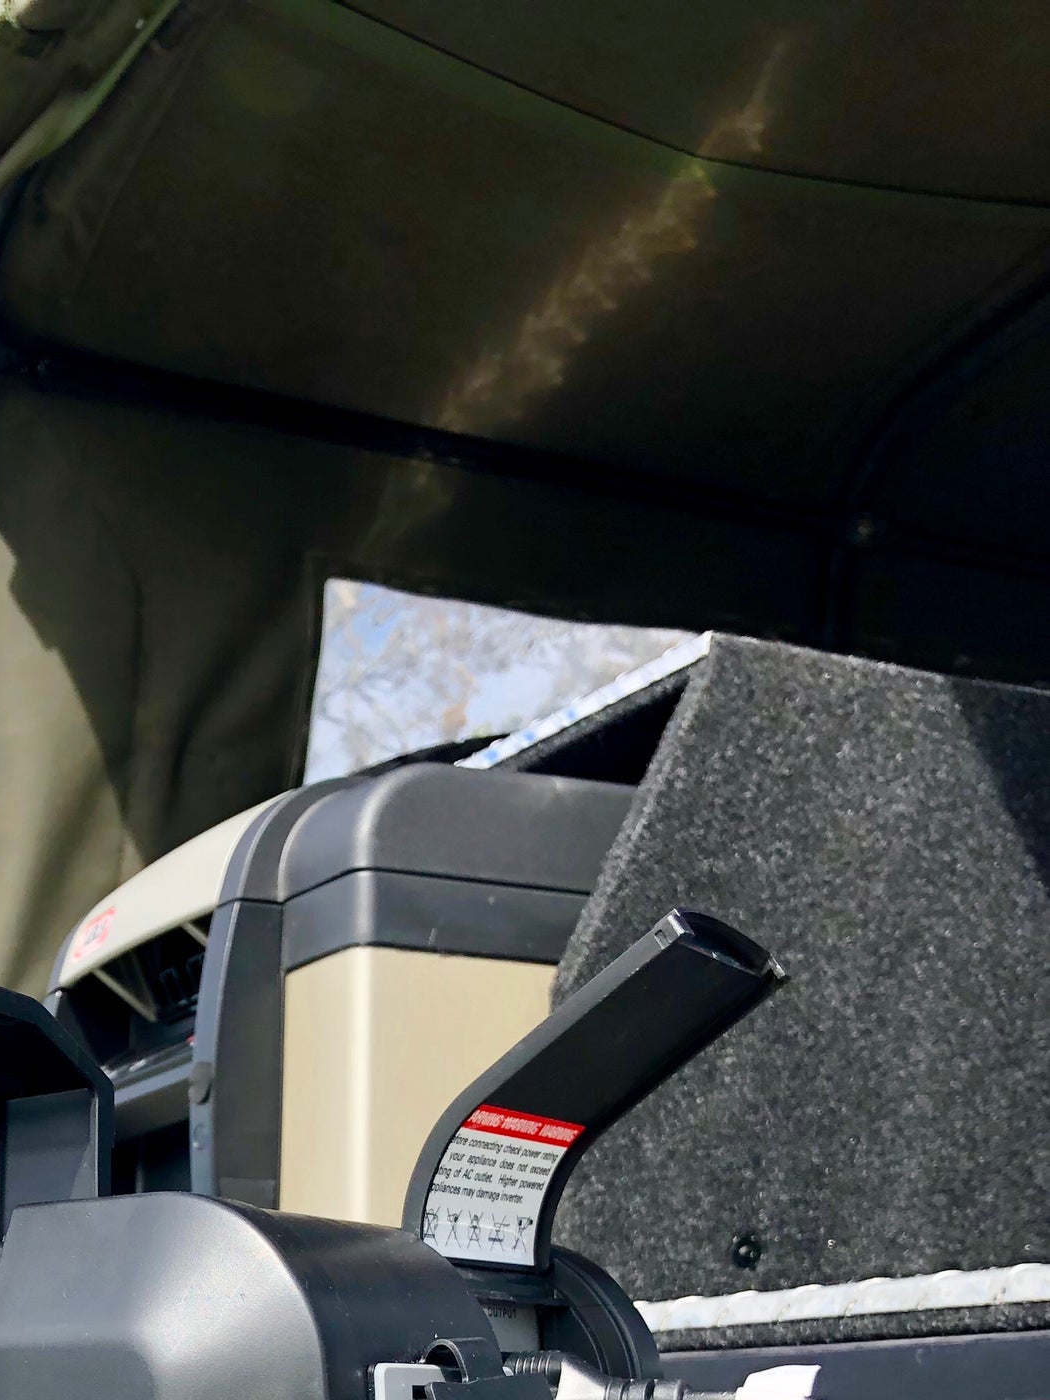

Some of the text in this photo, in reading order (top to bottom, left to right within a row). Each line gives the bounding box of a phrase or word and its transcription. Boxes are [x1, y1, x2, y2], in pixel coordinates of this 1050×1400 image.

[468, 1110, 503, 1127] ARNING
[468, 1138, 503, 1153] connecting
[503, 1144, 523, 1154] check
[520, 1148, 542, 1158] power
[449, 1151, 551, 1177] your appliance does not exceed
[453, 1169, 461, 1178] of
[462, 1169, 473, 1180] AC
[499, 1174, 519, 1188] Higher
[518, 1179, 544, 1191] powered
[460, 1186, 475, 1199] may
[476, 1188, 501, 1203] damage
